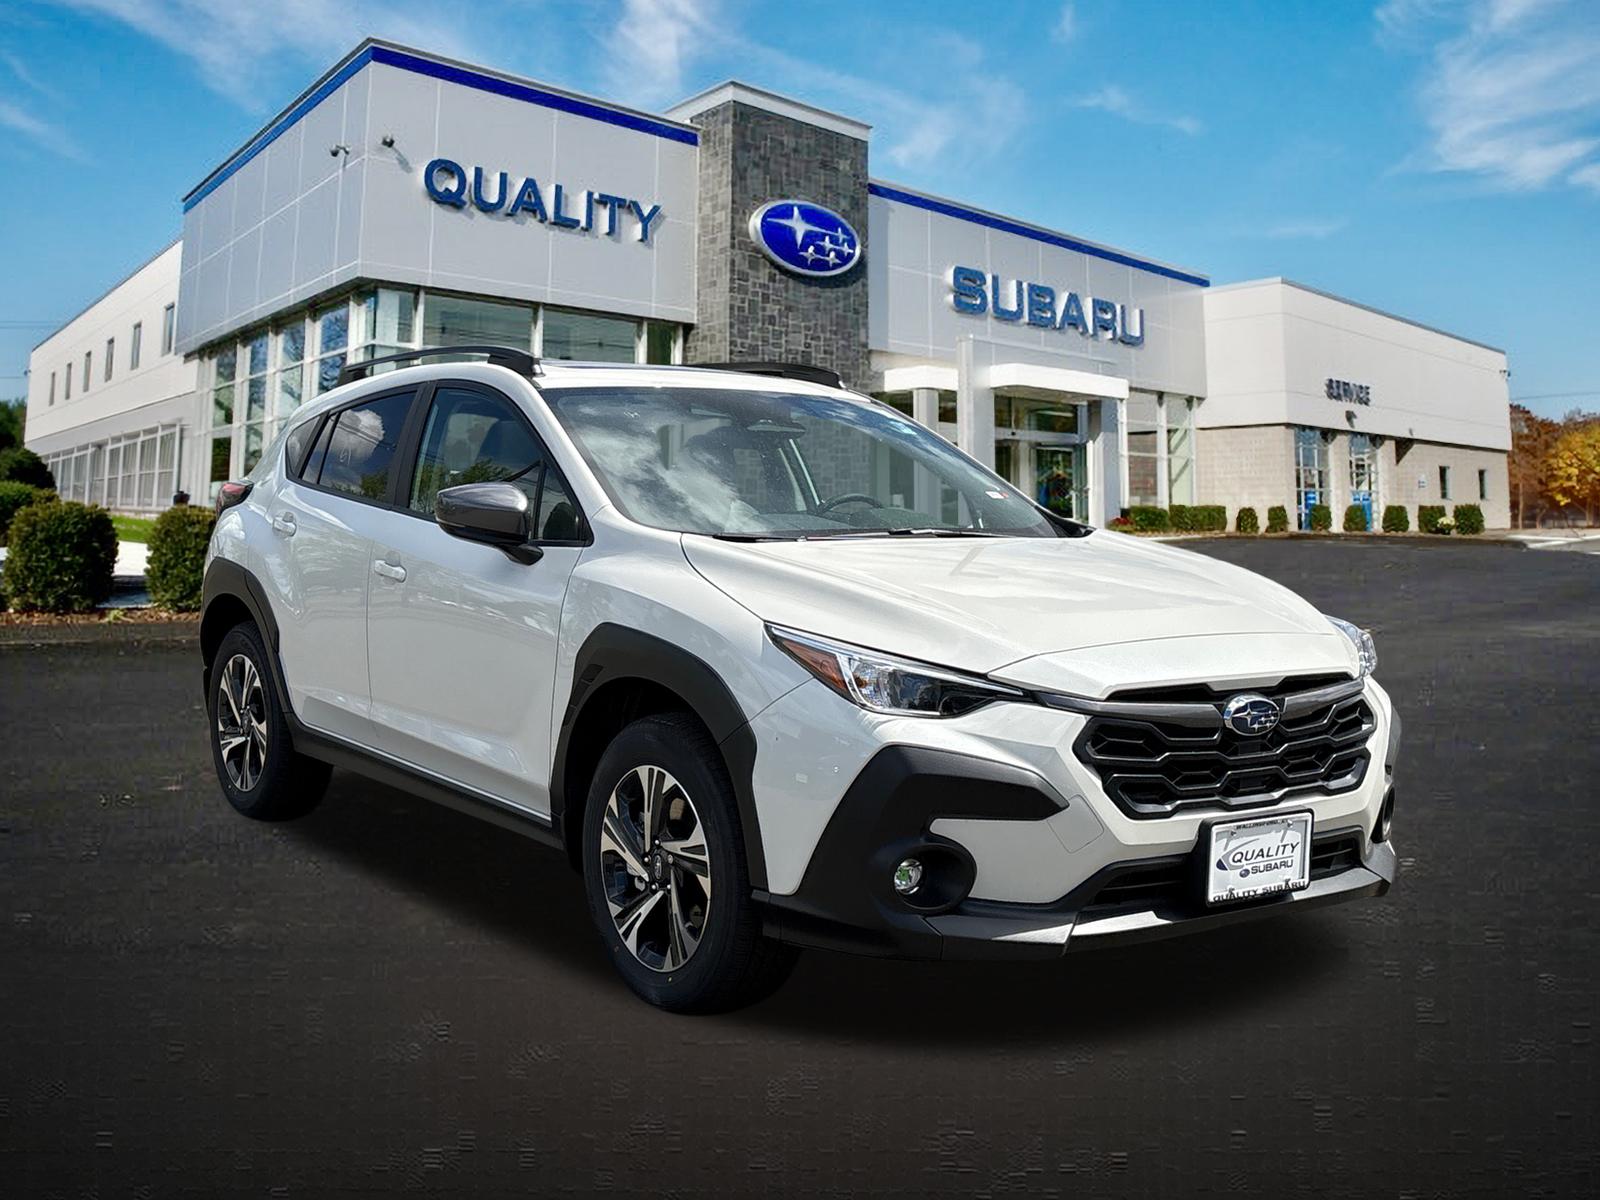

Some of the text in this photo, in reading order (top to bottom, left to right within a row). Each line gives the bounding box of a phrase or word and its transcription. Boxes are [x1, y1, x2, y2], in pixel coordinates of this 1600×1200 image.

[423, 158, 661, 242] QUALITY
[950, 265, 1145, 346] SUBARU
[1231, 841, 1300, 864] QUALITY
[1251, 859, 1294, 875] SUBARU
[1213, 880, 1306, 902] QUALITY SUBARU
